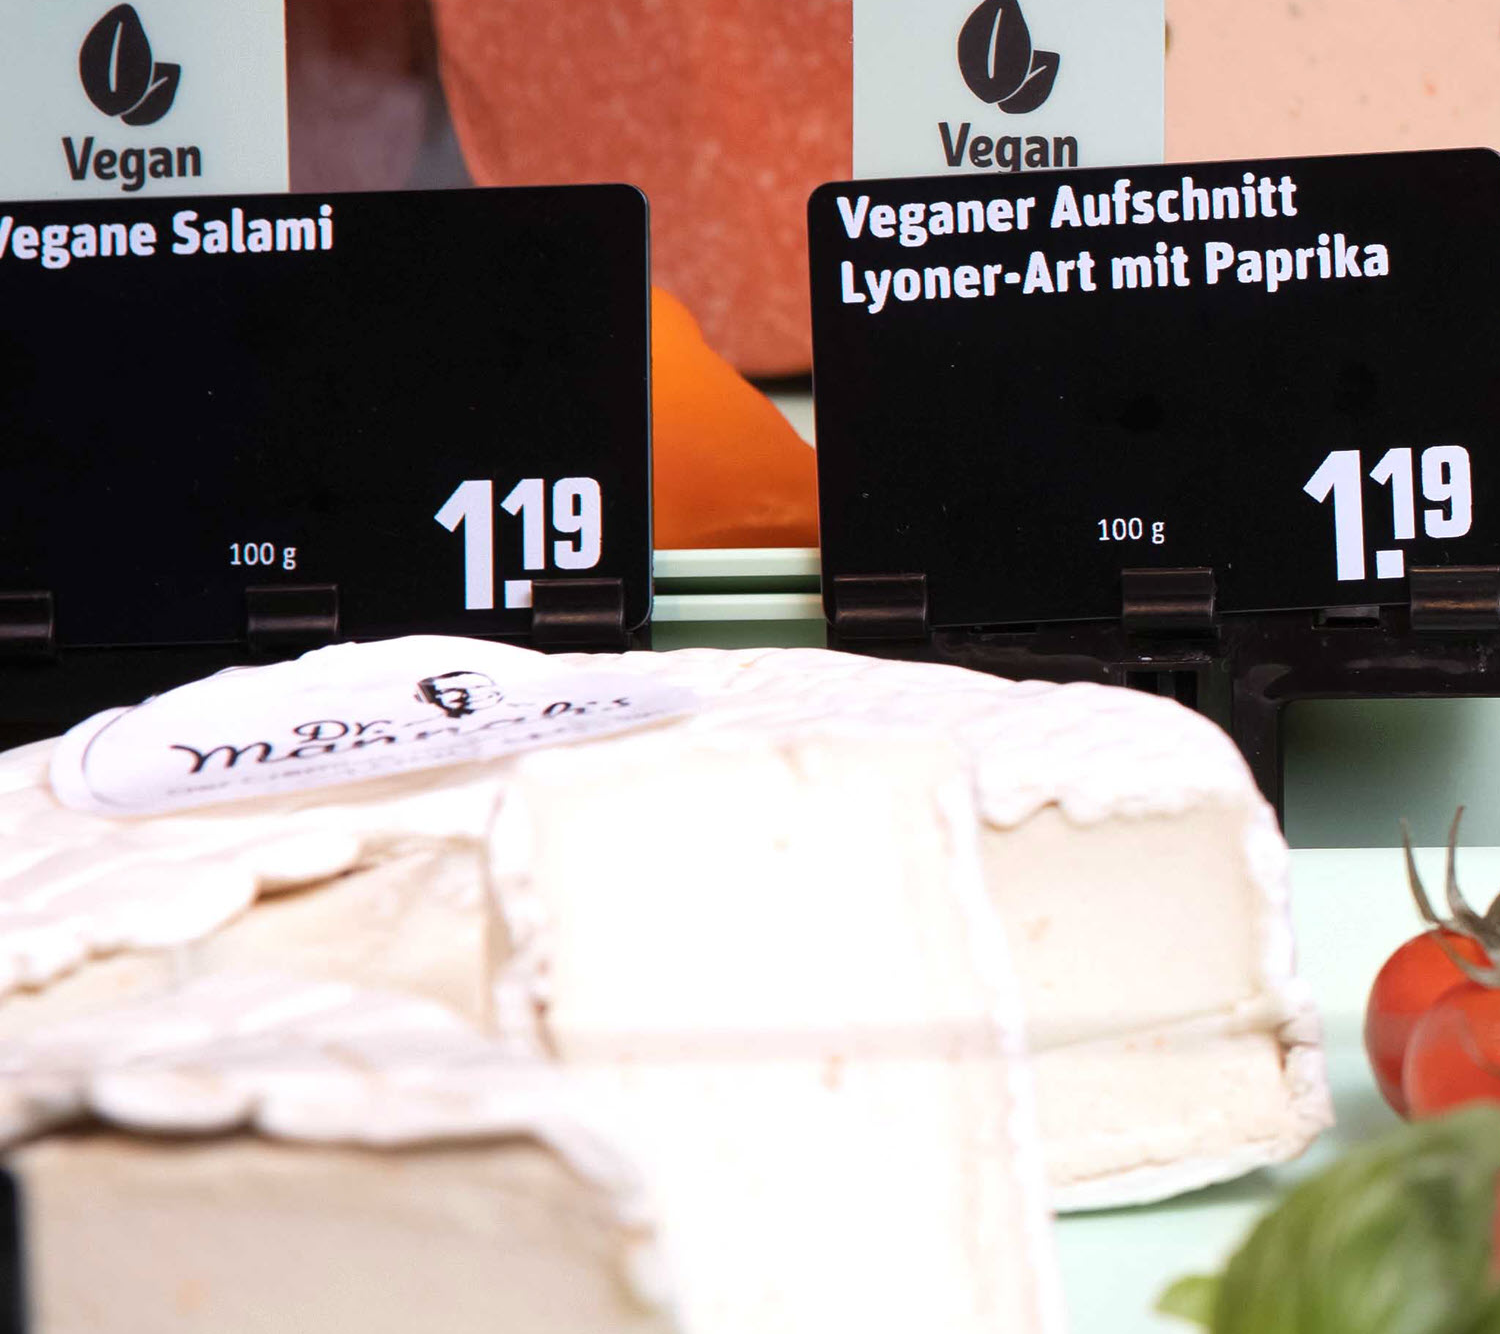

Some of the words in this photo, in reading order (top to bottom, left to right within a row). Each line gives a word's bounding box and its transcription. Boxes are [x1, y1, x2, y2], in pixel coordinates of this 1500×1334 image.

[61, 136, 202, 193] Vegan
[938, 121, 1081, 172] Vegan
[172, 203, 333, 255] Salami
[836, 195, 1036, 248] Veganer
[1050, 171, 1298, 229] Aufschnitt
[840, 250, 1097, 315] Lyoner-Art
[1111, 241, 1191, 290] mit
[1205, 232, 1389, 293] Paprika
[1097, 517, 1143, 541] 100
[1151, 521, 1165, 545] g
[1302, 444, 1473, 581] 1.19
[229, 542, 275, 566] 100
[282, 546, 297, 571] g
[433, 476, 602, 610] 1.19
